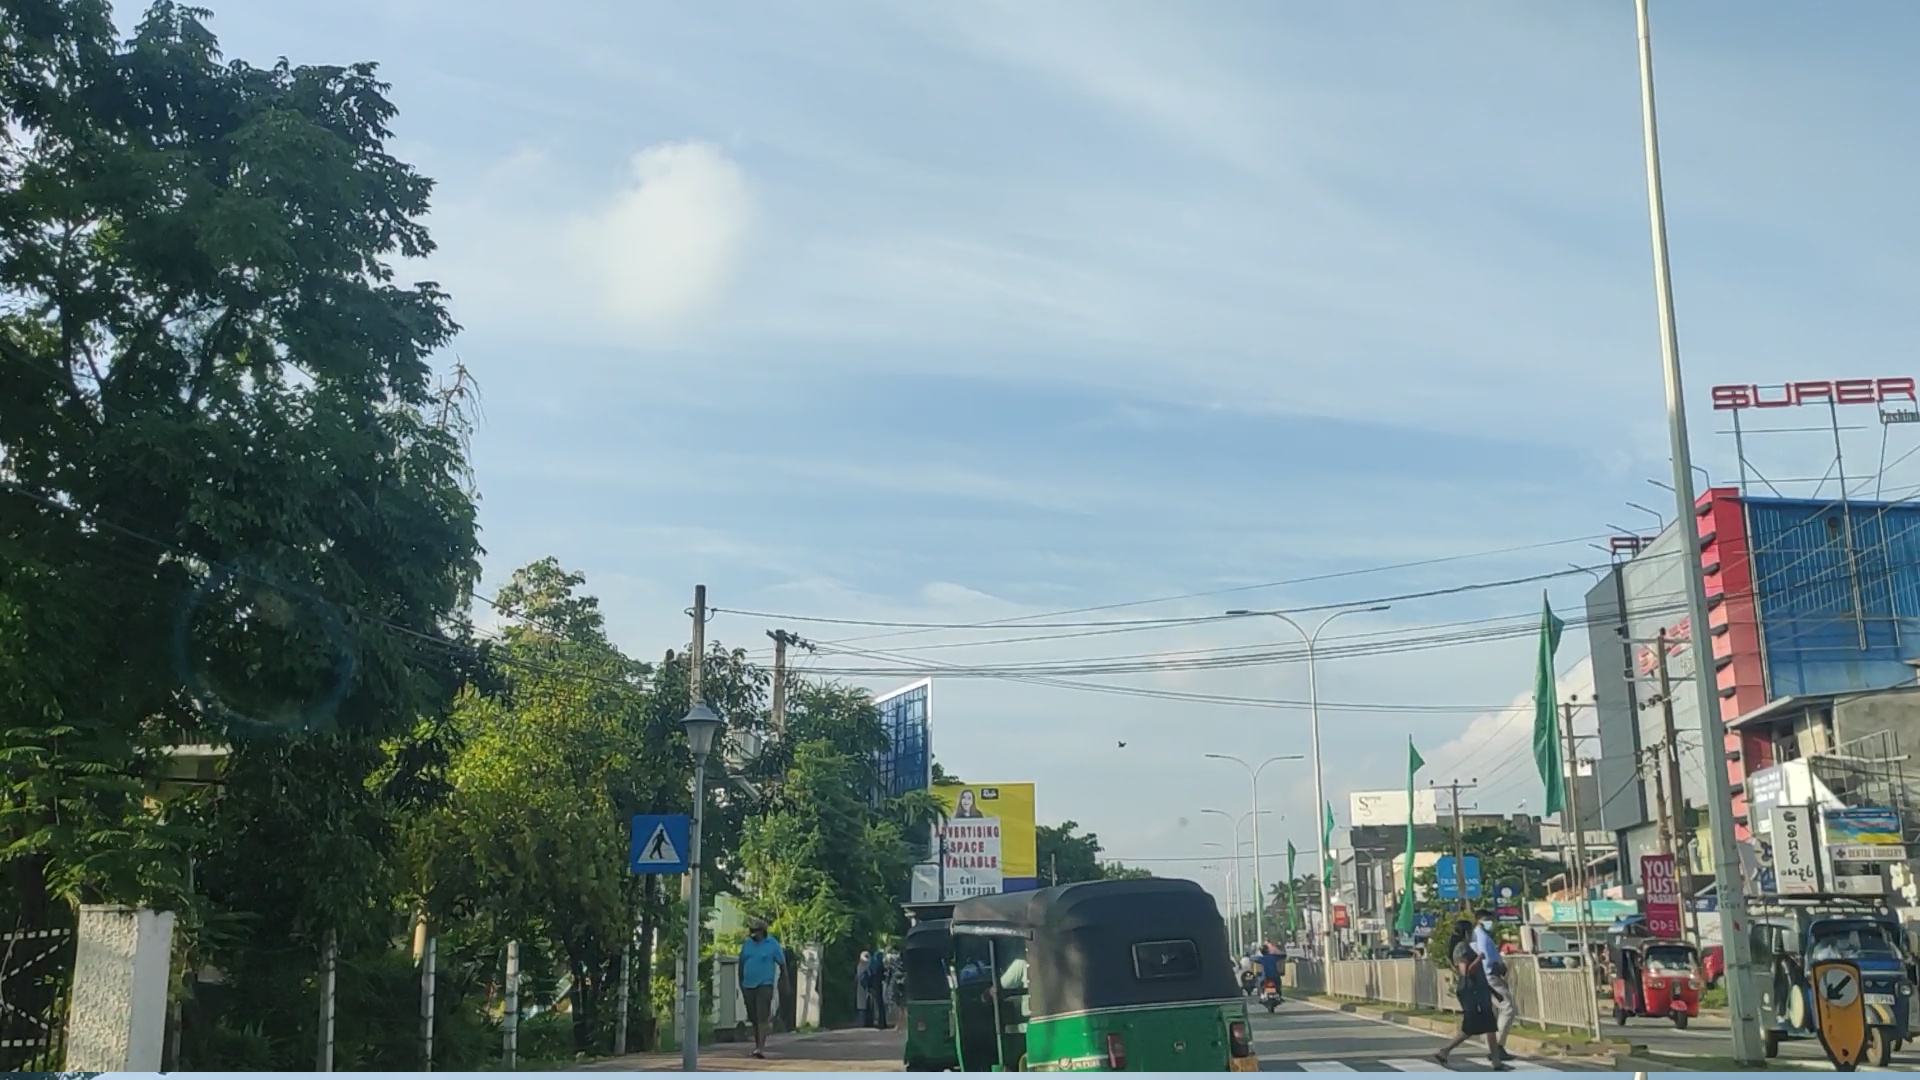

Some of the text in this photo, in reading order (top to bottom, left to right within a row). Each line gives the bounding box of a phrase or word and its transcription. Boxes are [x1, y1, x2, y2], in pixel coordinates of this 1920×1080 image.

[1712, 377, 1917, 410] SUPER
[950, 841, 985, 854] SPACE
[944, 856, 998, 869] VAILABLE
[1644, 860, 1675, 877] YOU
[1647, 877, 1676, 894] JUST
